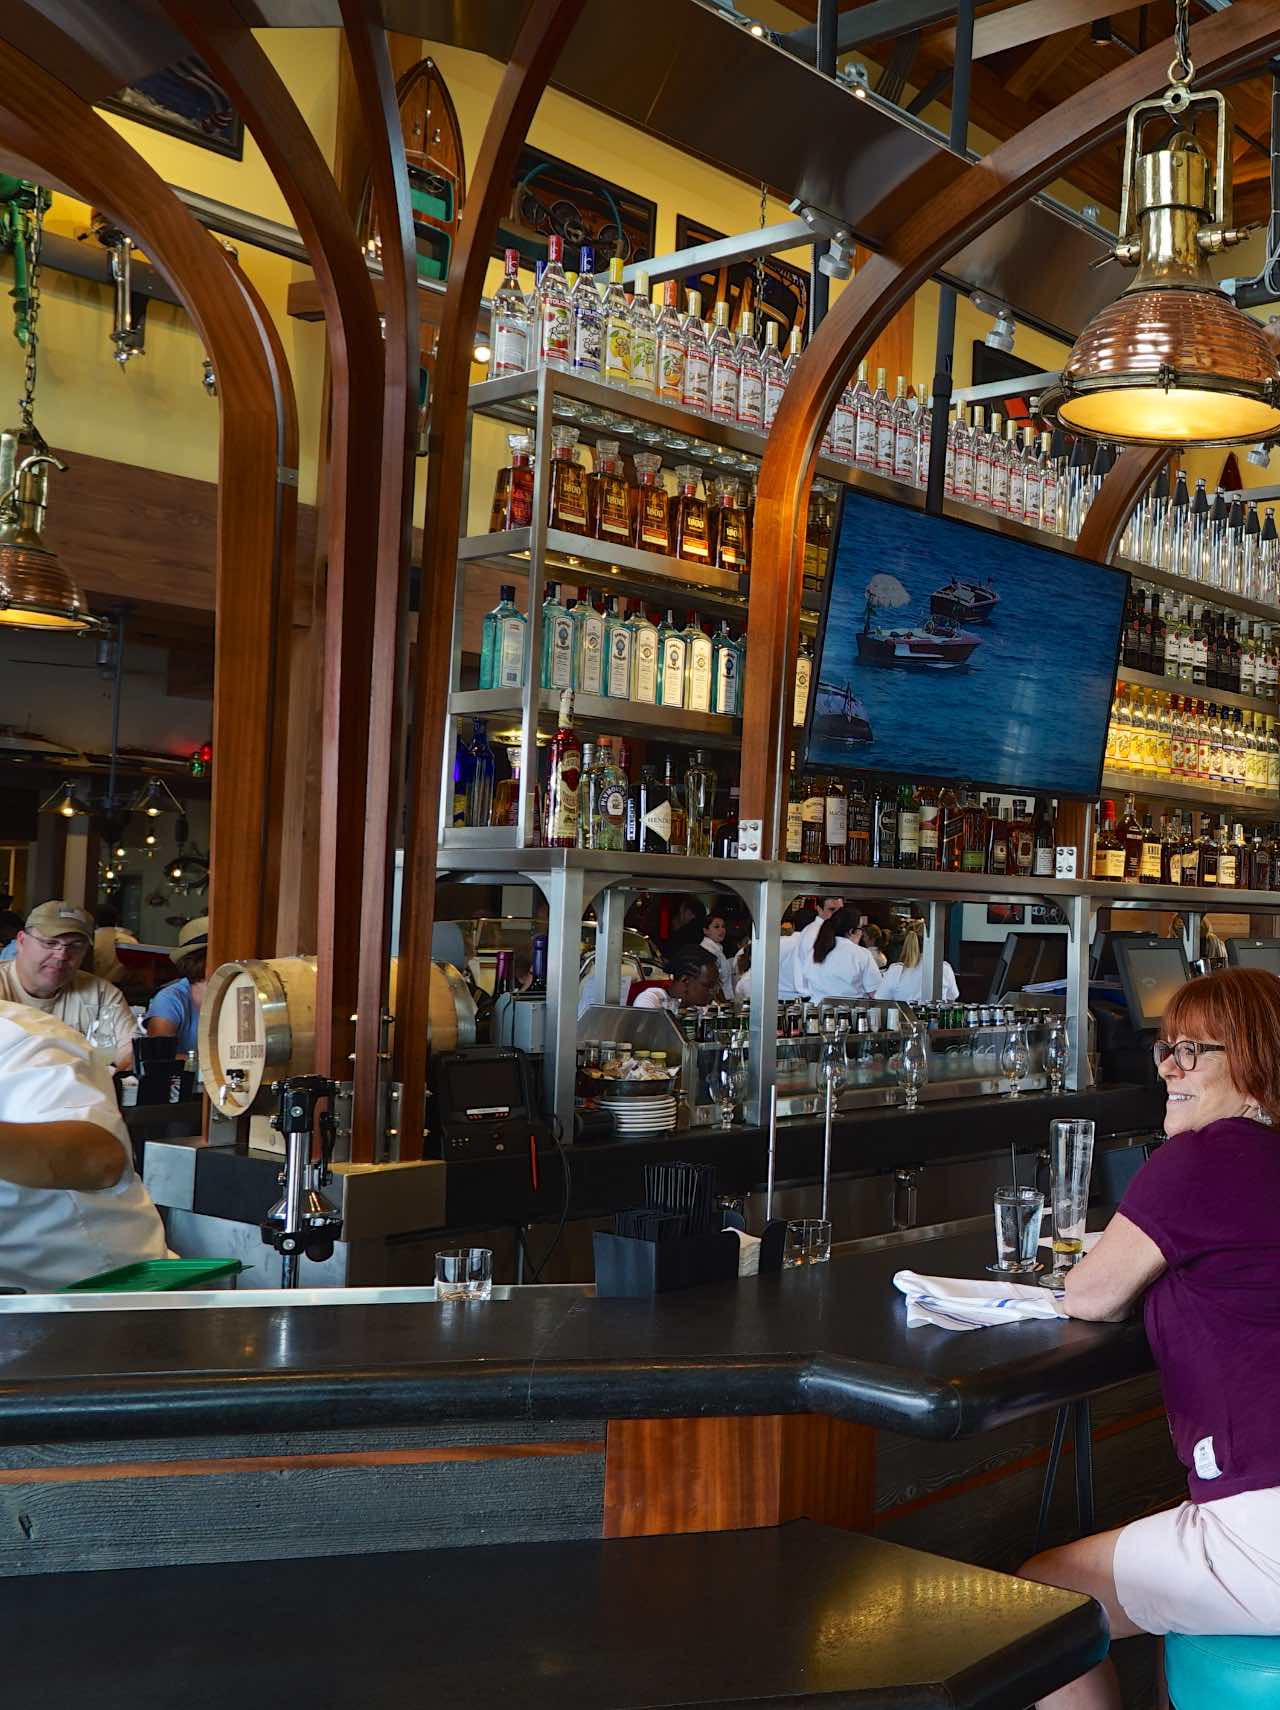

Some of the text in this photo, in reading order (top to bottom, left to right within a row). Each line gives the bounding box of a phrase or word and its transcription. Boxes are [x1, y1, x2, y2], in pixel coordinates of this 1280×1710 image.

[563, 485, 581, 494] 1800
[607, 495, 625, 505] 1800
[646, 507, 664, 518] 1800
[687, 517, 704, 528] 1800
